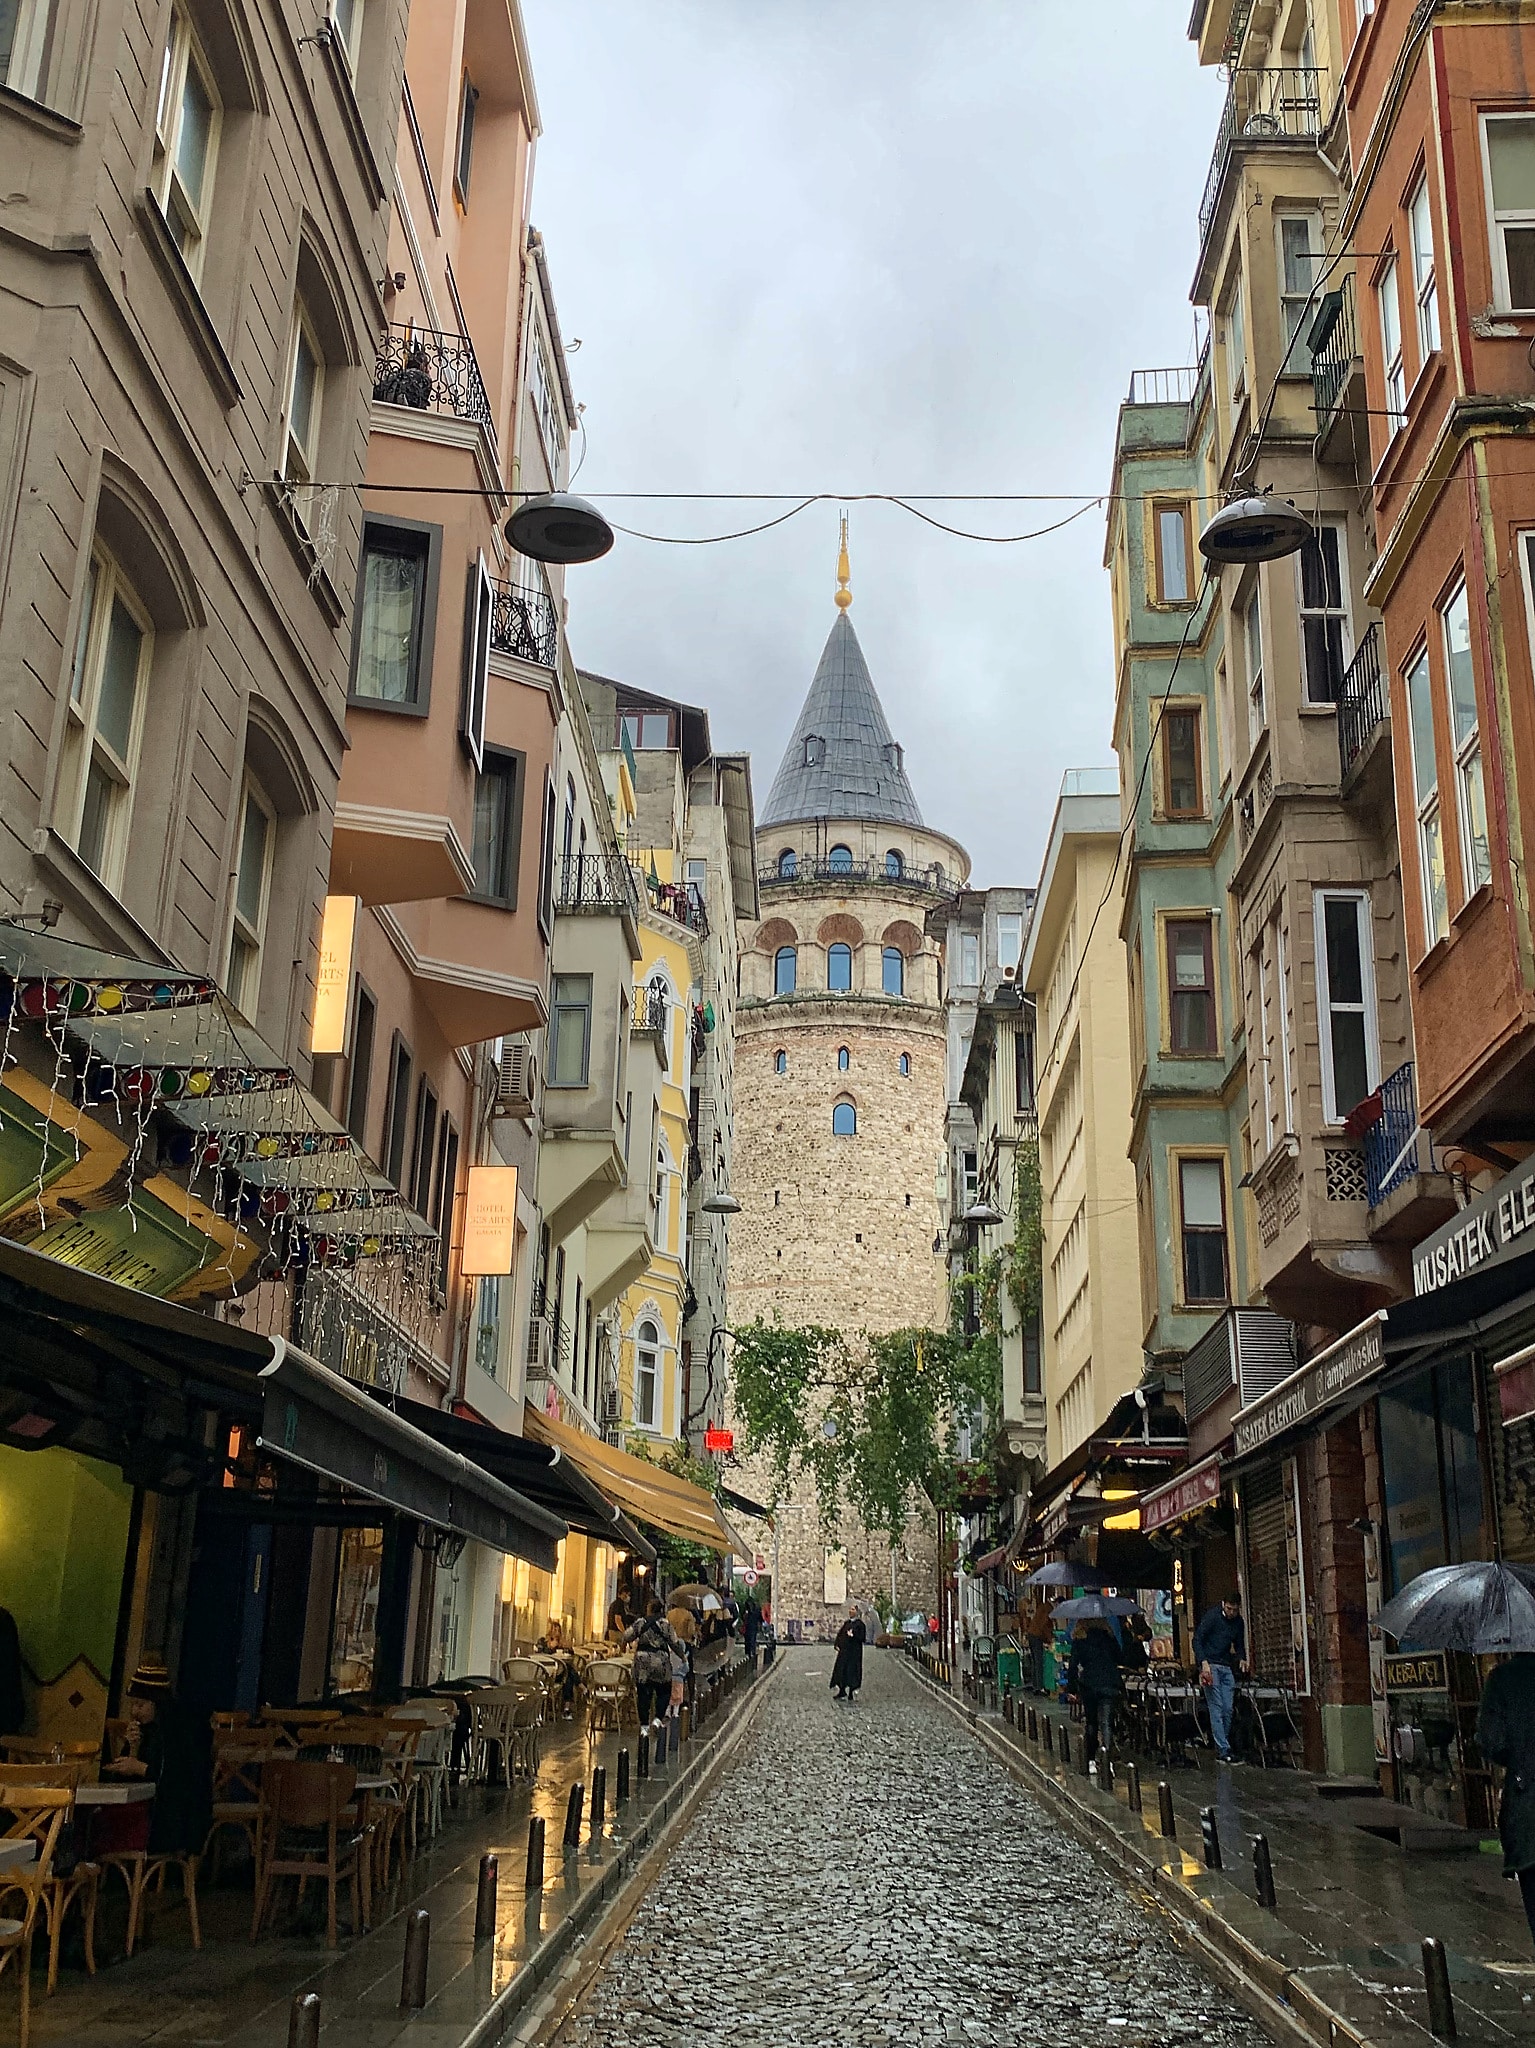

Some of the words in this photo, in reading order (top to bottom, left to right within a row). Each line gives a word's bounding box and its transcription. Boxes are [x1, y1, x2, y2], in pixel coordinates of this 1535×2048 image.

[476, 1203, 506, 1213] HOTEL
[488, 1215, 511, 1224] ARTS
[1413, 1210, 1492, 1297] MUSATEK
